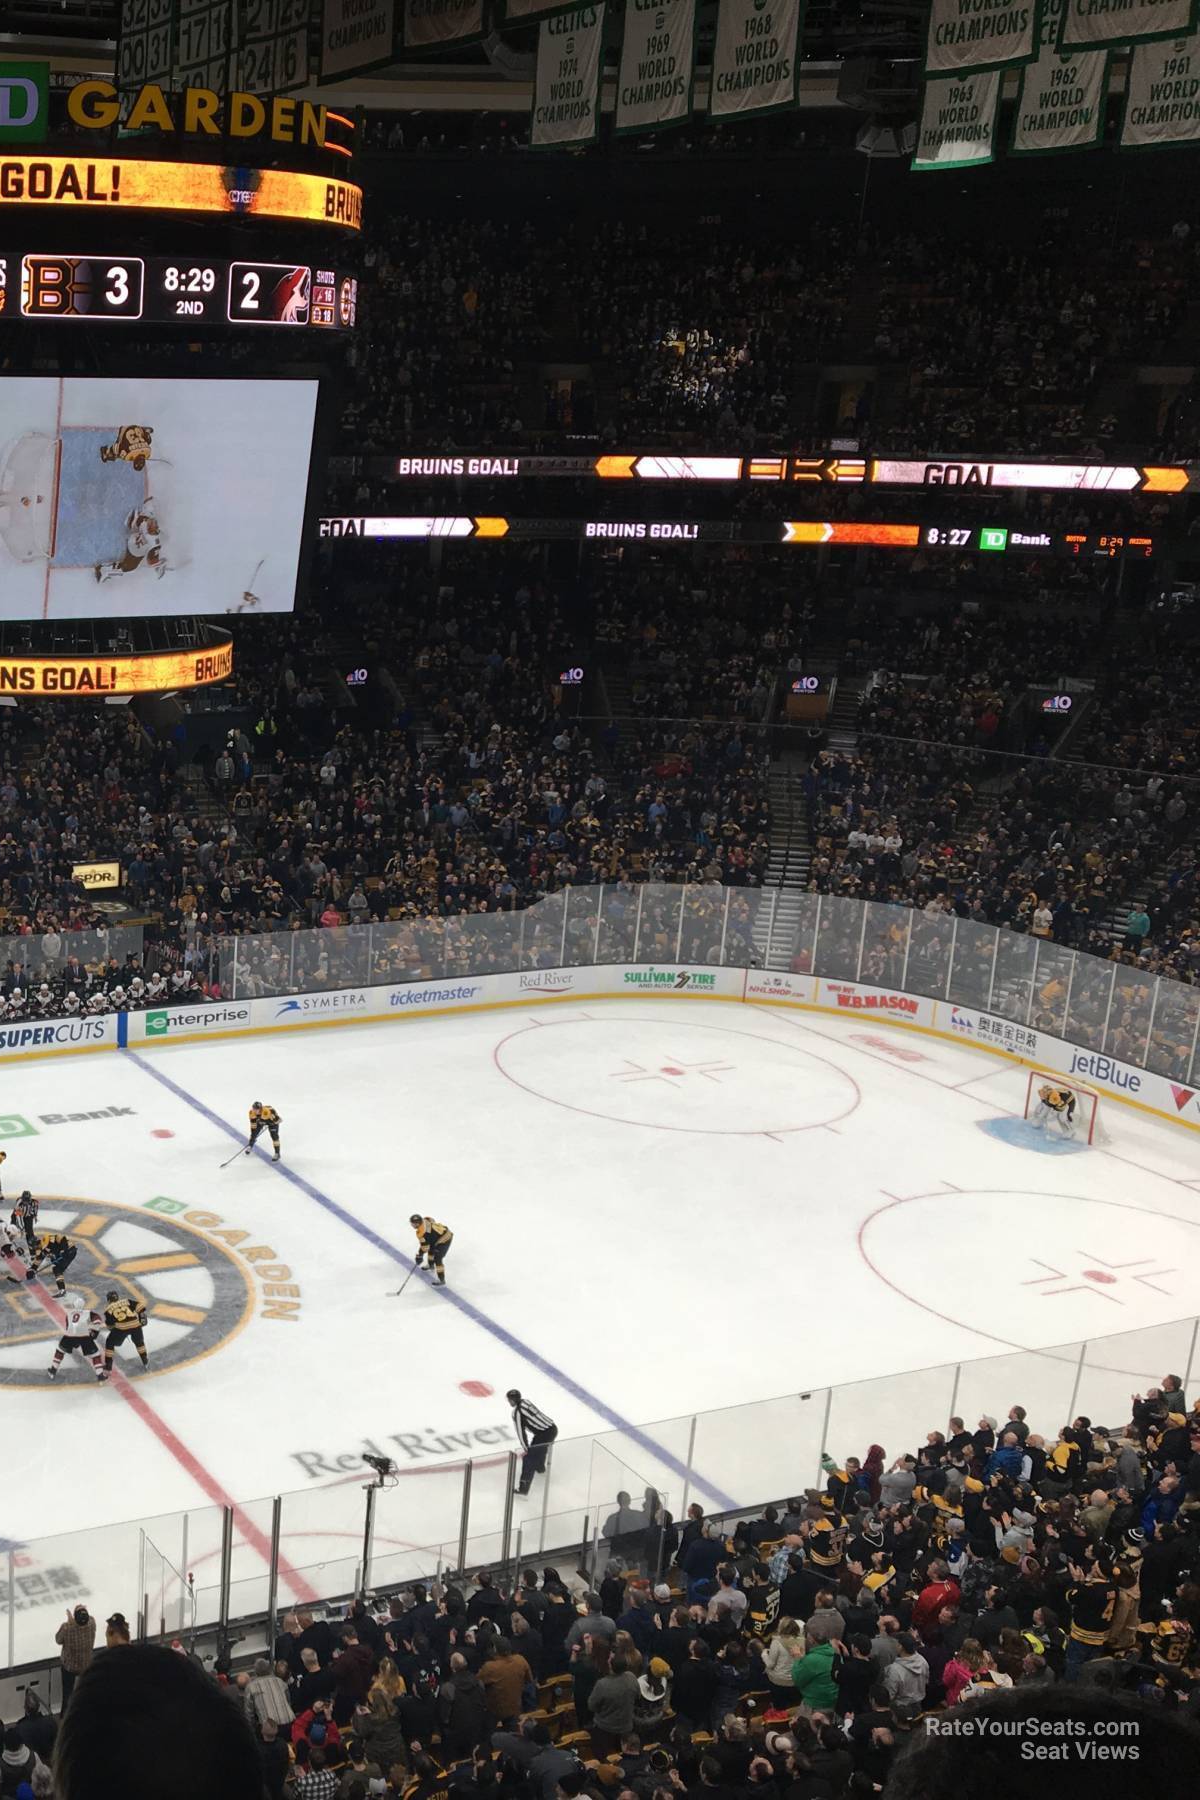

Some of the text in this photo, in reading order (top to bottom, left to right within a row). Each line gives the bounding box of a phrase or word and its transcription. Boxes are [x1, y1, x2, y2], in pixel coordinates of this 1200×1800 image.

[183, 16, 207, 60] 17
[328, 14, 386, 50] CHAMPIONS
[744, 17, 772, 39] 1968
[936, 9, 1028, 46] CHAMPIONS
[151, 28, 169, 71] 31
[646, 33, 670, 56] 1969
[735, 39, 778, 67] WORLD
[122, 38, 145, 78] 00
[557, 56, 579, 77] 1974
[638, 56, 676, 79] WORLD
[1163, 57, 1191, 78] 1961
[717, 59, 791, 93] CHAMPIONS
[1050, 67, 1077, 87] 1962
[550, 81, 584, 98] WORLD
[622, 76, 686, 106] CHAMPIONS
[949, 85, 974, 105] 1963
[1039, 87, 1083, 108] WORLD
[1150, 79, 1199, 102] WORLD
[67, 83, 328, 148] GARDEN
[537, 100, 591, 125] CHAMPIONS
[938, 105, 979, 125] WORLD
[923, 124, 990, 147] CHAMPIONS
[0, 163, 121, 201] GOAL!
[105, 266, 130, 305] 3
[164, 266, 216, 293] 8:29
[240, 271, 261, 309] 2
[176, 301, 204, 316] 2ND
[399, 458, 519, 476] BRUINS GOAL!
[586, 522, 699, 539] BRUINS GOAL!
[984, 531, 1051, 547] TD Bank
[1073, 544, 1080, 553] 3
[1099, 537, 1124, 548] 8:29
[1145, 547, 1152, 557] 2
[43, 666, 117, 690] GOAL!
[354, 668, 368, 681] 10
[569, 667, 584, 681] 10
[805, 676, 819, 690] 10
[1054, 695, 1072, 709] 10
[519, 971, 574, 988] Red River
[691, 972, 716, 984] TIRE
[303, 994, 366, 1009] SYMETRA
[389, 985, 477, 1007] ticketmaster
[152, 1007, 249, 1032] enterprise
[1068, 1048, 1141, 1092] jetBlue
[37, 1104, 138, 1126] Bank
[183, 1210, 303, 1322] GARDEN
[71, 1312, 81, 1324] 9
[289, 1423, 516, 1479] Red River
